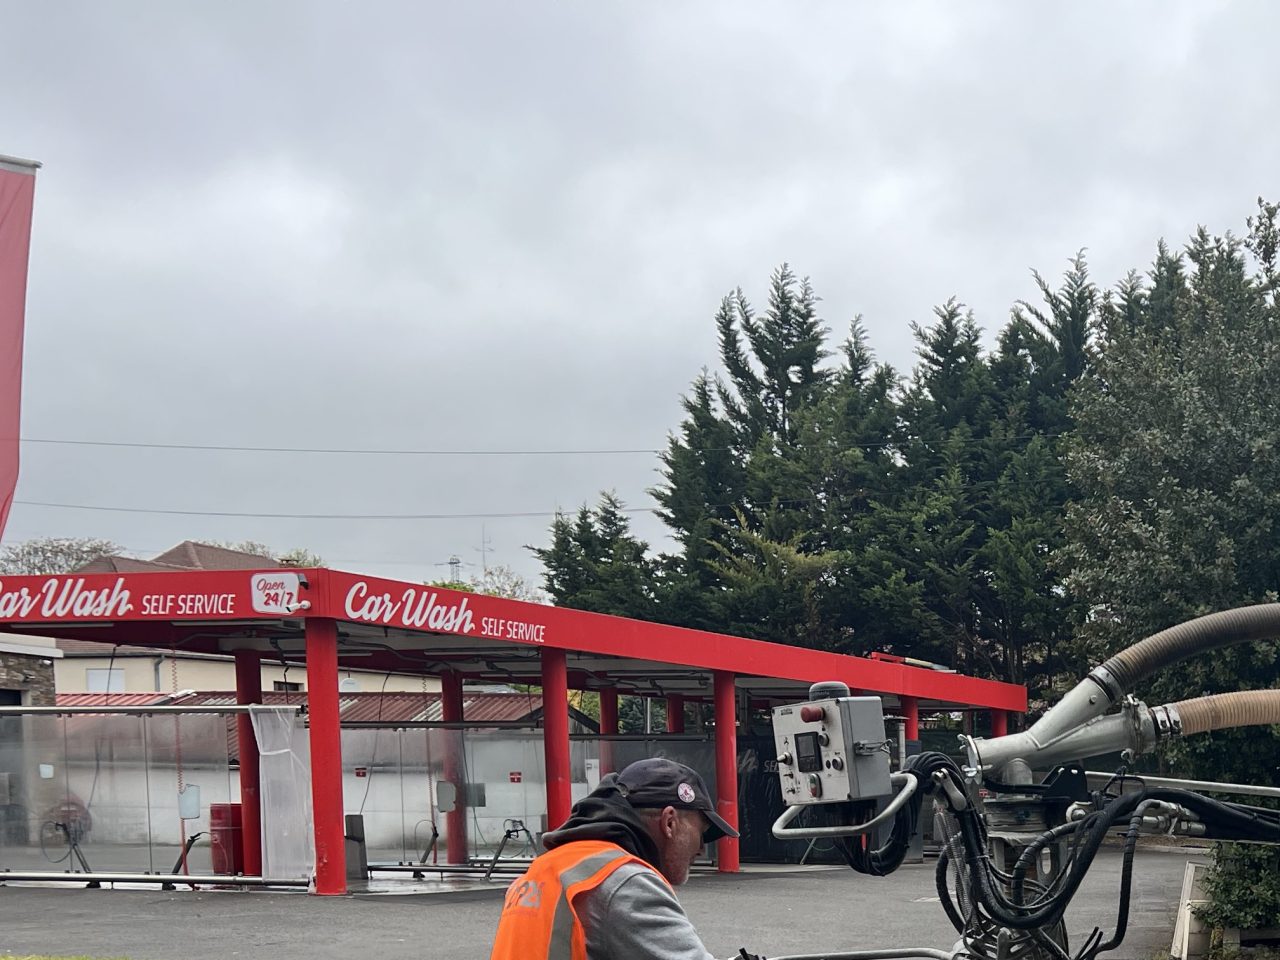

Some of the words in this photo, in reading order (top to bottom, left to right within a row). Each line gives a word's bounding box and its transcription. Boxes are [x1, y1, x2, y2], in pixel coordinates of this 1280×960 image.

[0, 581, 41, 618] ar
[41, 578, 134, 617] Wash
[141, 594, 176, 615] SELF
[176, 593, 236, 615] SERVICE
[256, 578, 285, 594] Open
[264, 590, 294, 607] 24/7
[344, 581, 401, 623] Car
[401, 588, 475, 634] Wash
[481, 616, 506, 636] SELF
[506, 620, 546, 643] SERVICE
